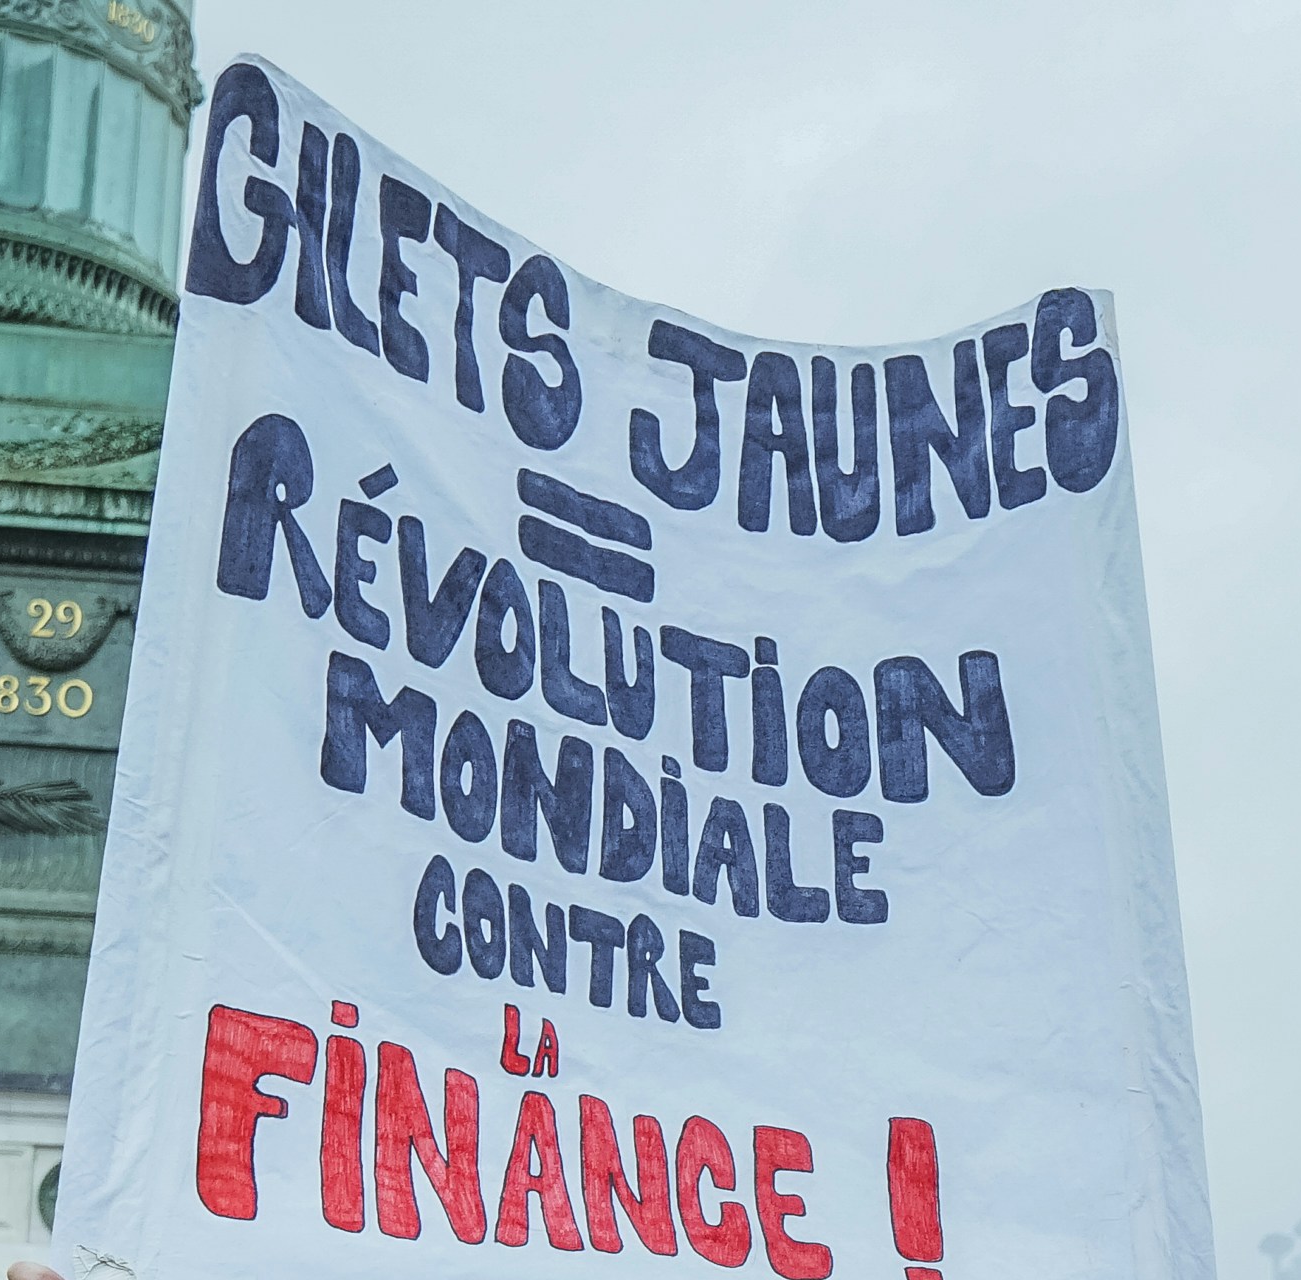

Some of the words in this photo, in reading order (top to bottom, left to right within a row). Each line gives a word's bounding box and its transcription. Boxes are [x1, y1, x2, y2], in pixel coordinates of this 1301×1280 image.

[185, 63, 583, 451] GILETS
[629, 287, 1119, 543] JAUNES
[27, 598, 83, 640] 29
[413, 854, 721, 1030] CONTRE
[500, 1003, 559, 1078] LA
